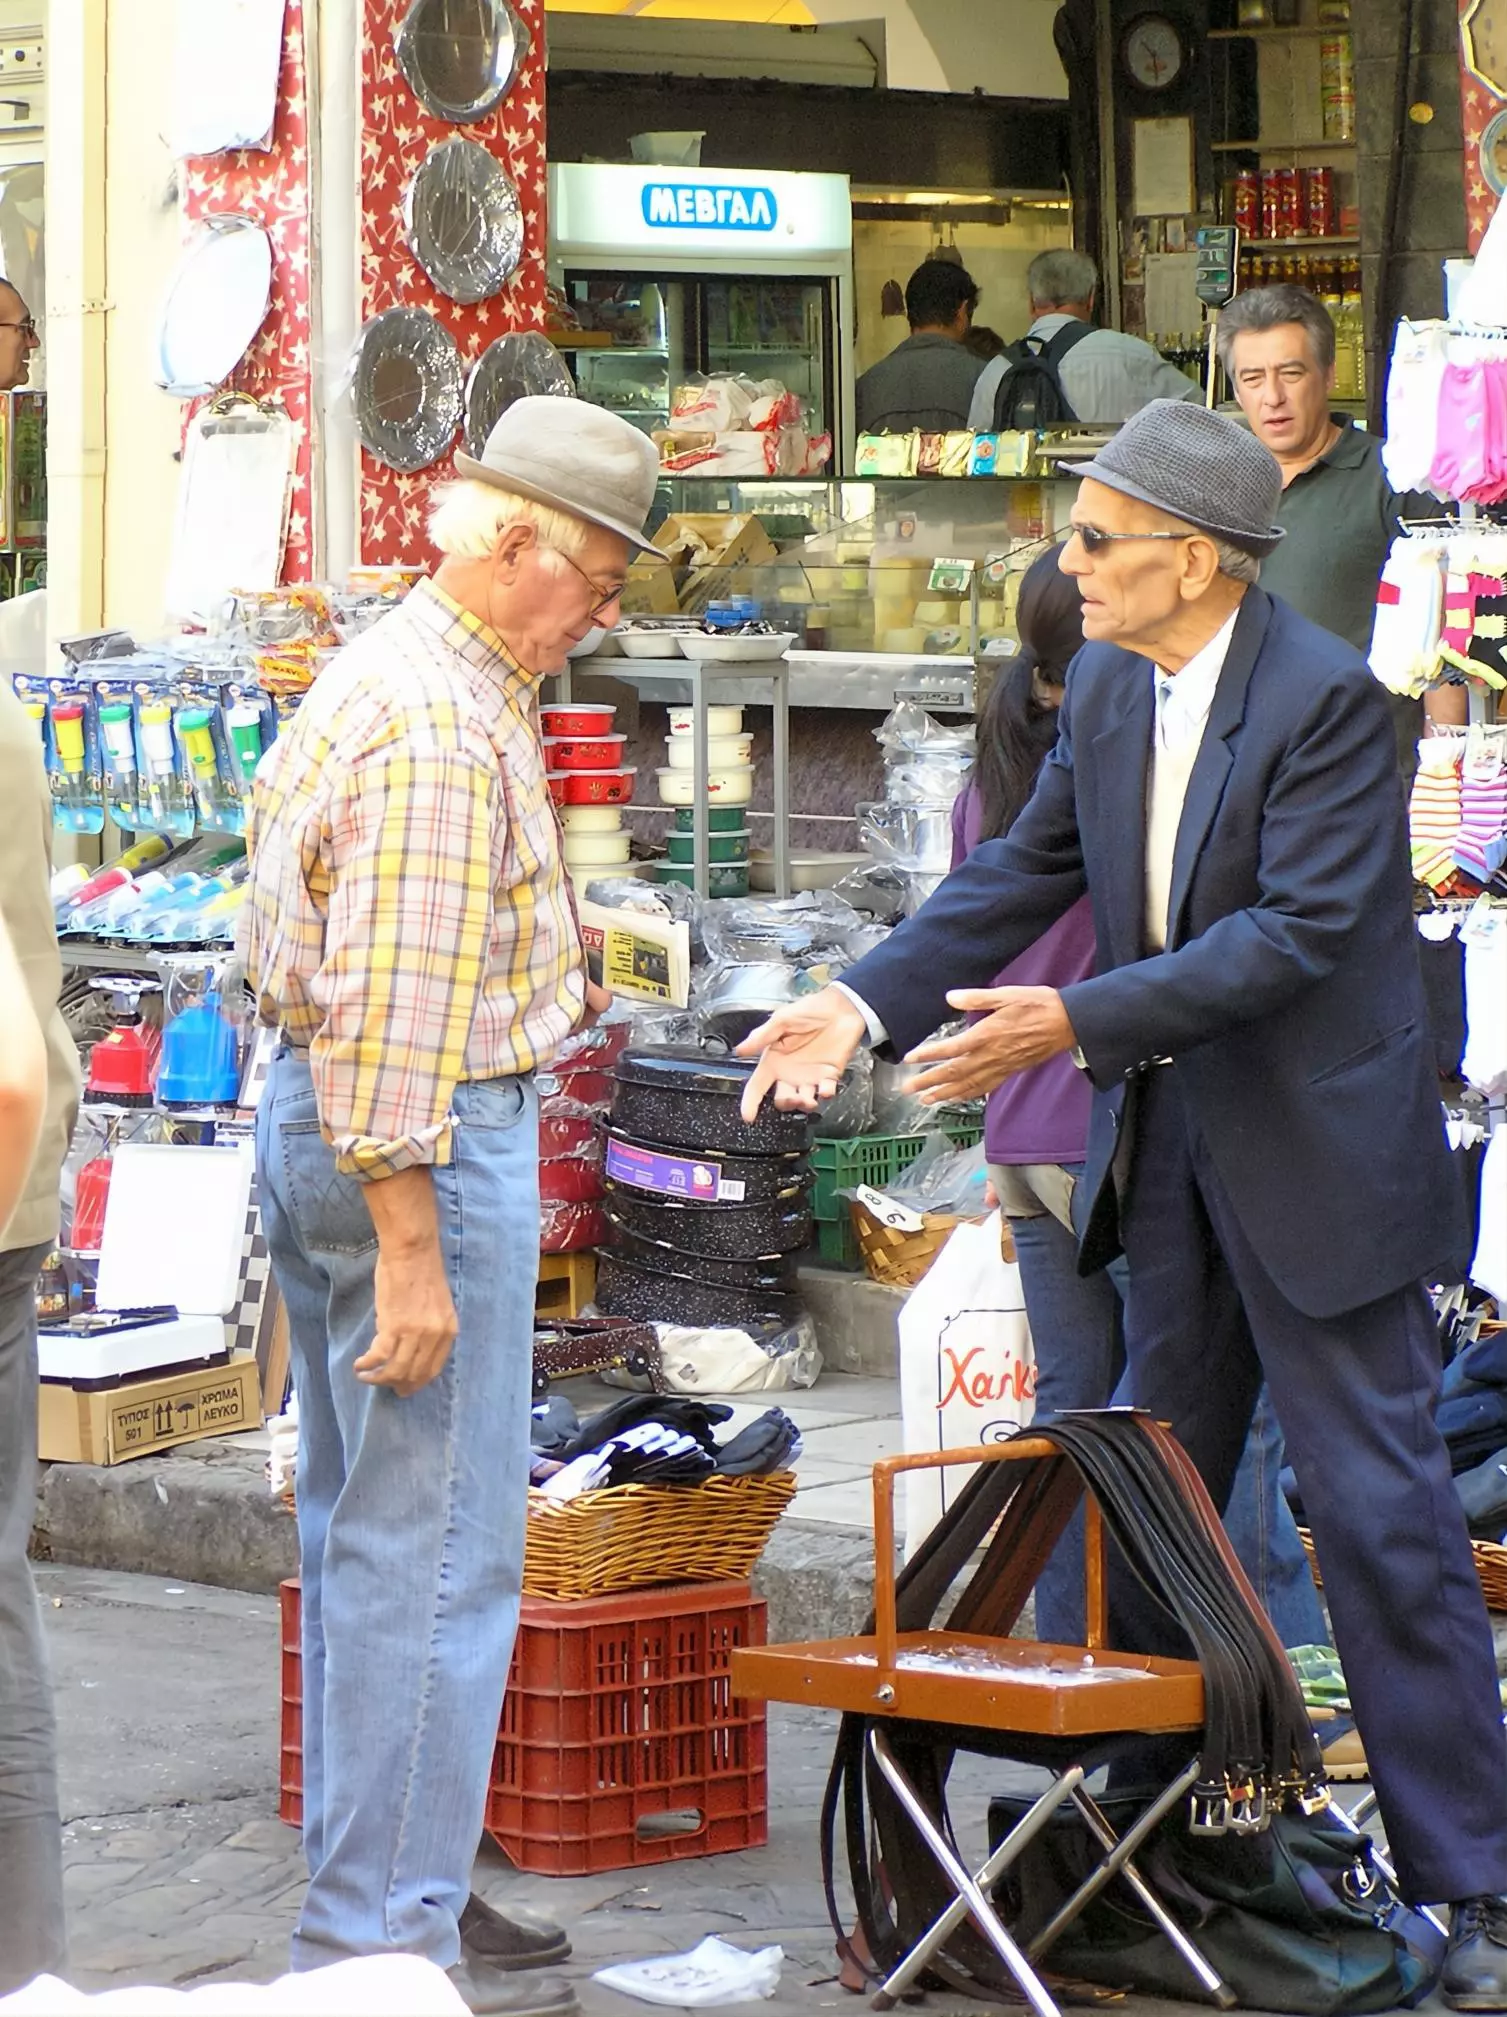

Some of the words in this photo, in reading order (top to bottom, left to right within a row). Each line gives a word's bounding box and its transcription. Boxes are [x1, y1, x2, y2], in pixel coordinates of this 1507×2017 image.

[649, 187, 772, 224] ΜΕΒΓΑΛ
[202, 1387, 238, 1405] ΧΡΩΜΑ
[118, 1408, 149, 1427] ΤΥΠΟΣ
[204, 1403, 238, 1421] ΛΕΥΚΟ
